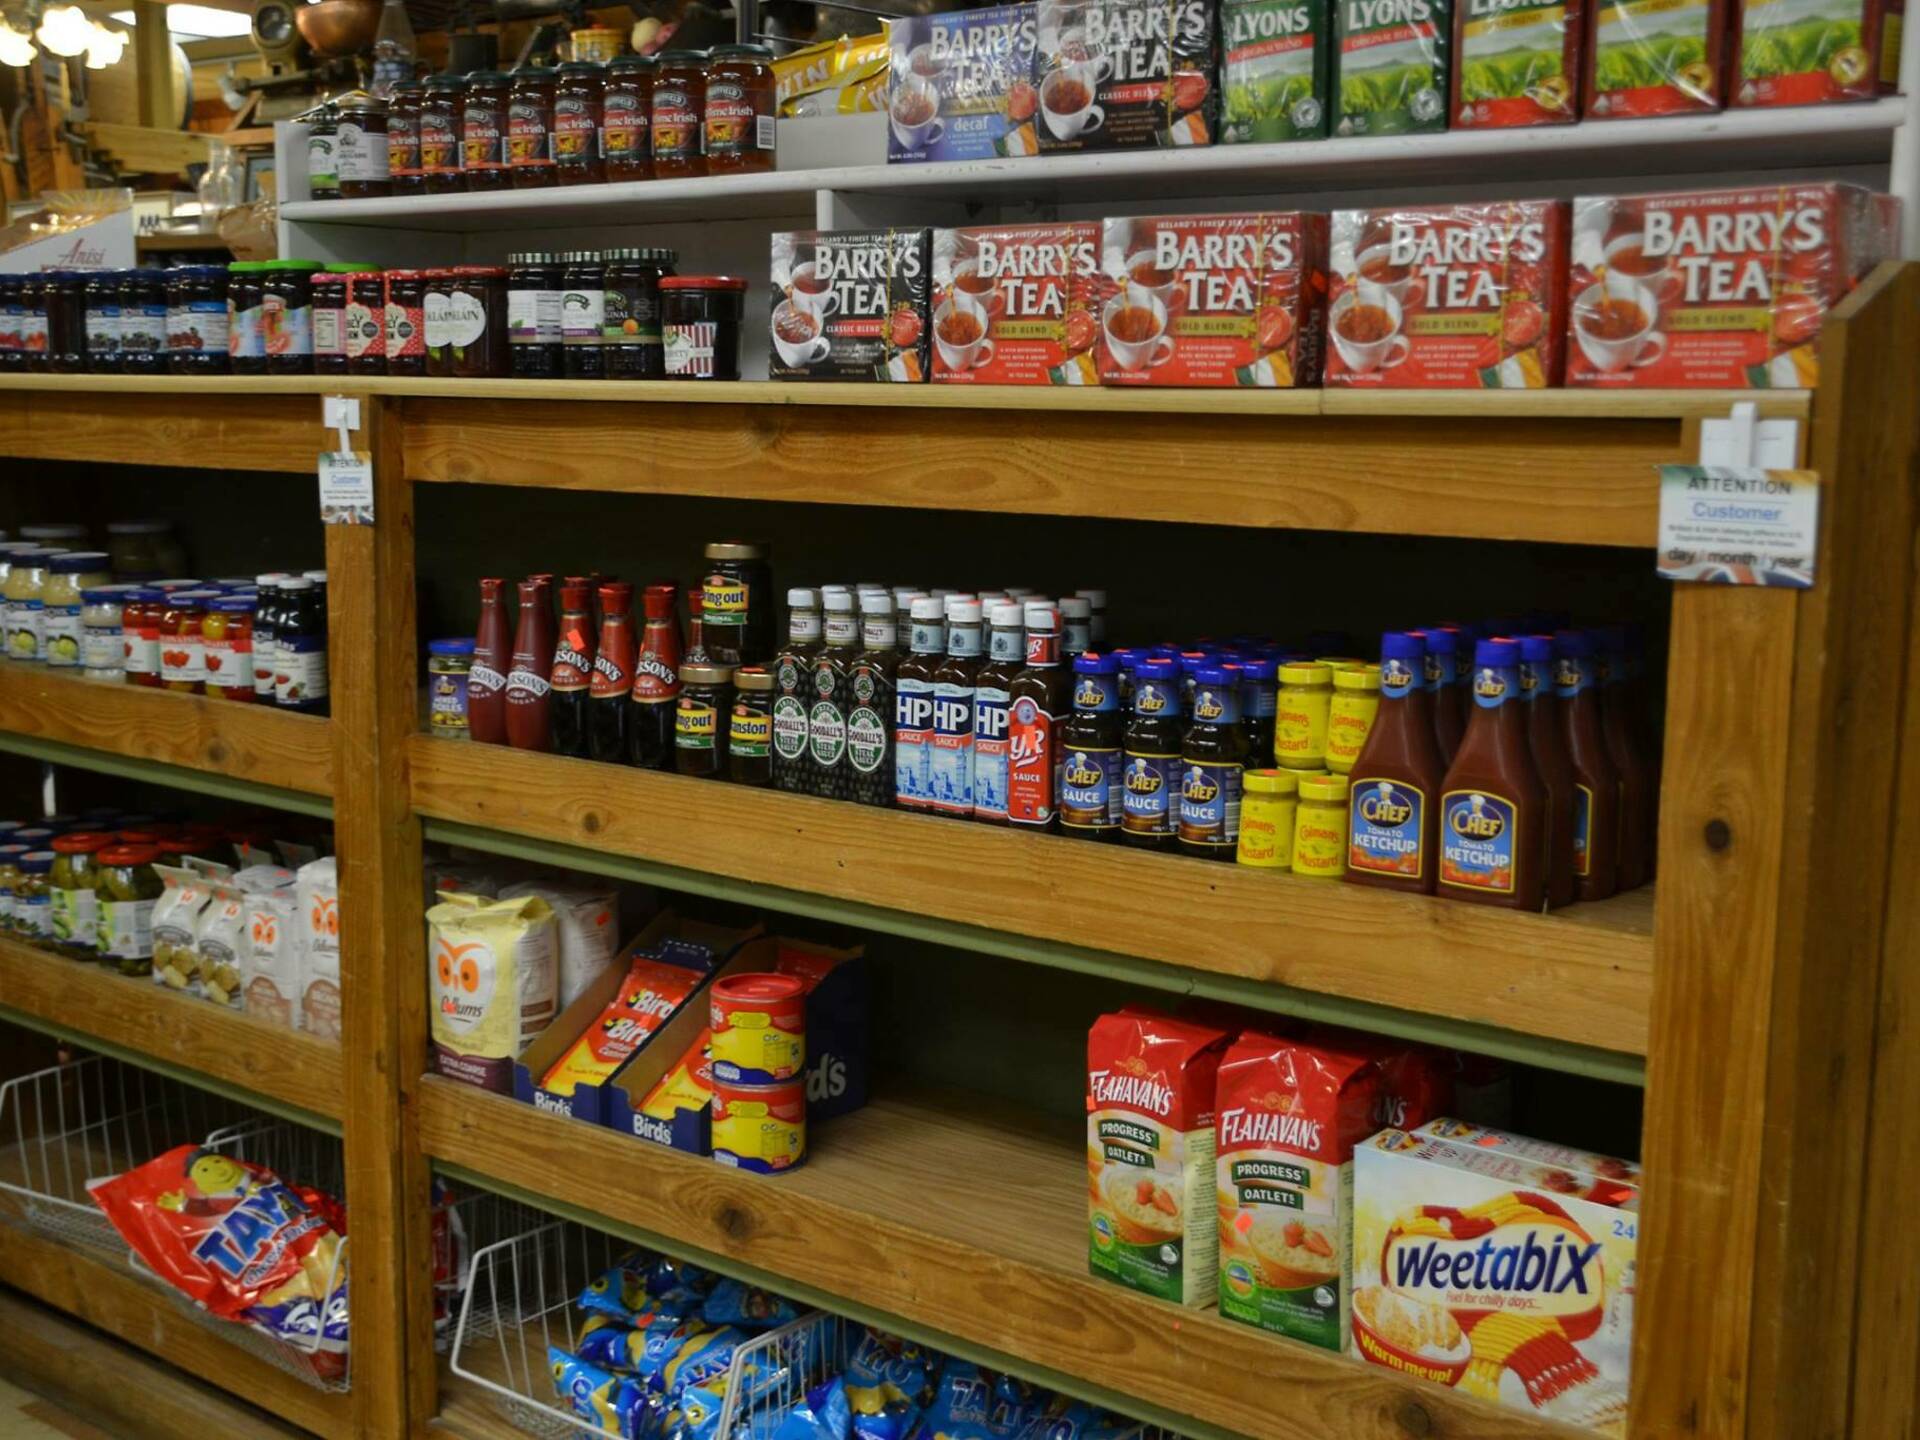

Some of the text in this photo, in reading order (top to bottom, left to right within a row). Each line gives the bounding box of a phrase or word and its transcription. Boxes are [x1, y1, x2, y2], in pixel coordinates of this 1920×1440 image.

[1085, 2, 1205, 45] BARRY'S
[1232, 7, 1310, 42] LYONS
[1349, 0, 1431, 30] LYONS
[930, 16, 1037, 60] BARRY'S
[1110, 45, 1169, 80] TEA
[953, 115, 989, 131] decaf
[1641, 202, 1825, 257] BARRY'S
[1155, 227, 1294, 270] BARRY'S
[1390, 222, 1545, 266] BARRY'S
[814, 245, 921, 280] BARRY'S
[977, 237, 1097, 278] BARRY'S
[1421, 266, 1500, 308] TEA
[1679, 256, 1771, 302] TEA
[835, 281, 889, 315] TEA
[1001, 279, 1063, 316] TEA
[1183, 271, 1253, 310] TEA
[857, 324, 880, 333] BLEND
[1688, 476, 1792, 495] ATTENTION
[1692, 502, 1782, 520] Customer
[1668, 547, 1697, 565] day
[1707, 551, 1758, 565] month
[1770, 556, 1805, 569] year
[723, 590, 744, 604] out
[1382, 668, 1411, 685] CHEF
[1474, 677, 1506, 696] CHEF
[1075, 689, 1104, 705] CHEF
[1136, 696, 1166, 712] CHEF
[691, 713, 712, 727] out
[896, 695, 932, 727] HP
[933, 698, 969, 732] HP
[976, 704, 1009, 737] HP
[1195, 702, 1222, 718] CHEF
[899, 732, 922, 742] SAUCE
[936, 737, 958, 747] SAUCE
[977, 742, 1000, 752] SAUCE
[1328, 740, 1361, 756] Mustar
[1013, 773, 1041, 783] SAUCE
[1064, 764, 1102, 785] CHEF
[1125, 770, 1162, 791] CHEF
[1063, 789, 1100, 804] SAUCE
[1182, 779, 1217, 800] CHEF
[1124, 795, 1160, 810] SAUCE
[1180, 803, 1216, 820] SAUCE
[1361, 797, 1411, 823] CHEF
[1366, 826, 1404, 838] TOMATO
[1452, 809, 1503, 836] CHEF
[1354, 832, 1418, 853] KETCHUP
[1458, 839, 1495, 852] TOMATO
[1446, 846, 1510, 867] KETCHUP
[804, 1053, 846, 1101] rd's
[1089, 1070, 1174, 1116] FLAHAVAN'S
[633, 1114, 672, 1146] Bird's
[1102, 1121, 1153, 1143] PROGRESS
[1220, 1108, 1321, 1152] FLAHAVAN'S
[1107, 1146, 1146, 1165] OATLETS
[1237, 1163, 1302, 1181] PROGRESS
[1244, 1188, 1295, 1205] OATLETS
[192, 1183, 303, 1279] TAY
[1613, 1219, 1636, 1240] 24
[1396, 1230, 1603, 1295] Weetabix
[1465, 1292, 1478, 1304] for
[1360, 1330, 1455, 1385] Warm me up!
